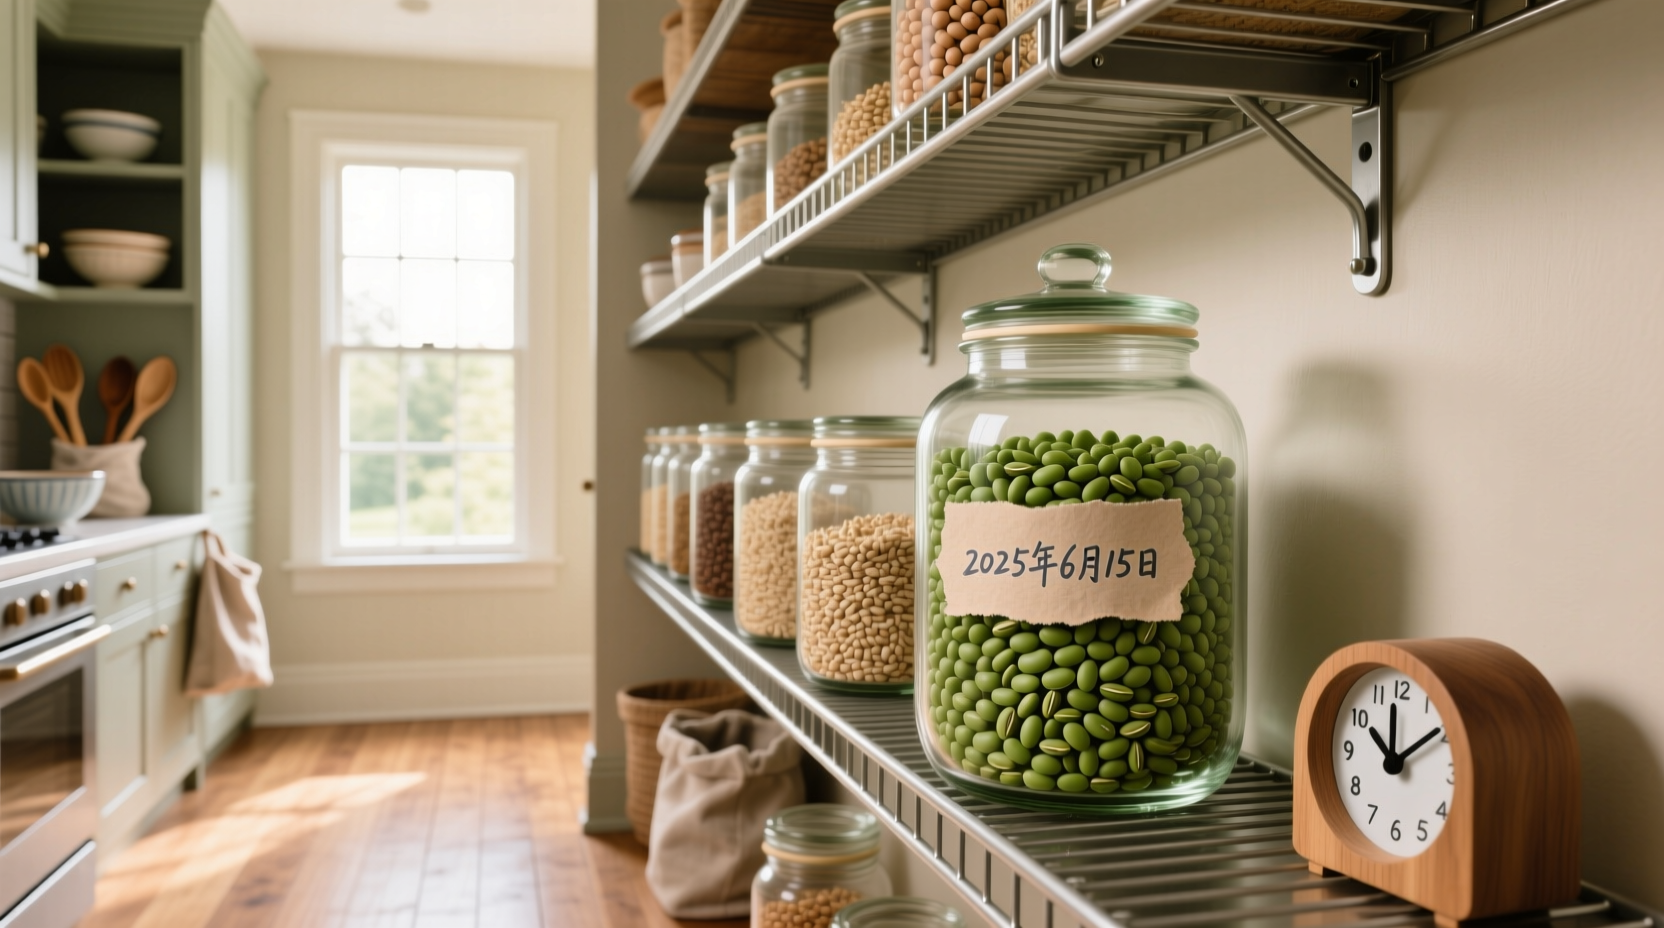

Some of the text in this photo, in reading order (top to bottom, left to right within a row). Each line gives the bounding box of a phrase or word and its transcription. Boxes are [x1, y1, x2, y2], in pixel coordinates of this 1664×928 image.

[963, 541, 1157, 587] 2025年6月15日
[1373, 684, 1384, 705] 11
[1395, 680, 1410, 700] 12
[1352, 708, 1368, 728] 10
[1344, 740, 1354, 760] 9
[1351, 776, 1361, 796] 8
[1368, 804, 1378, 825] 7
[1435, 801, 1448, 821] 4
[1391, 820, 1401, 841] 6
[1416, 819, 1428, 841] 5
